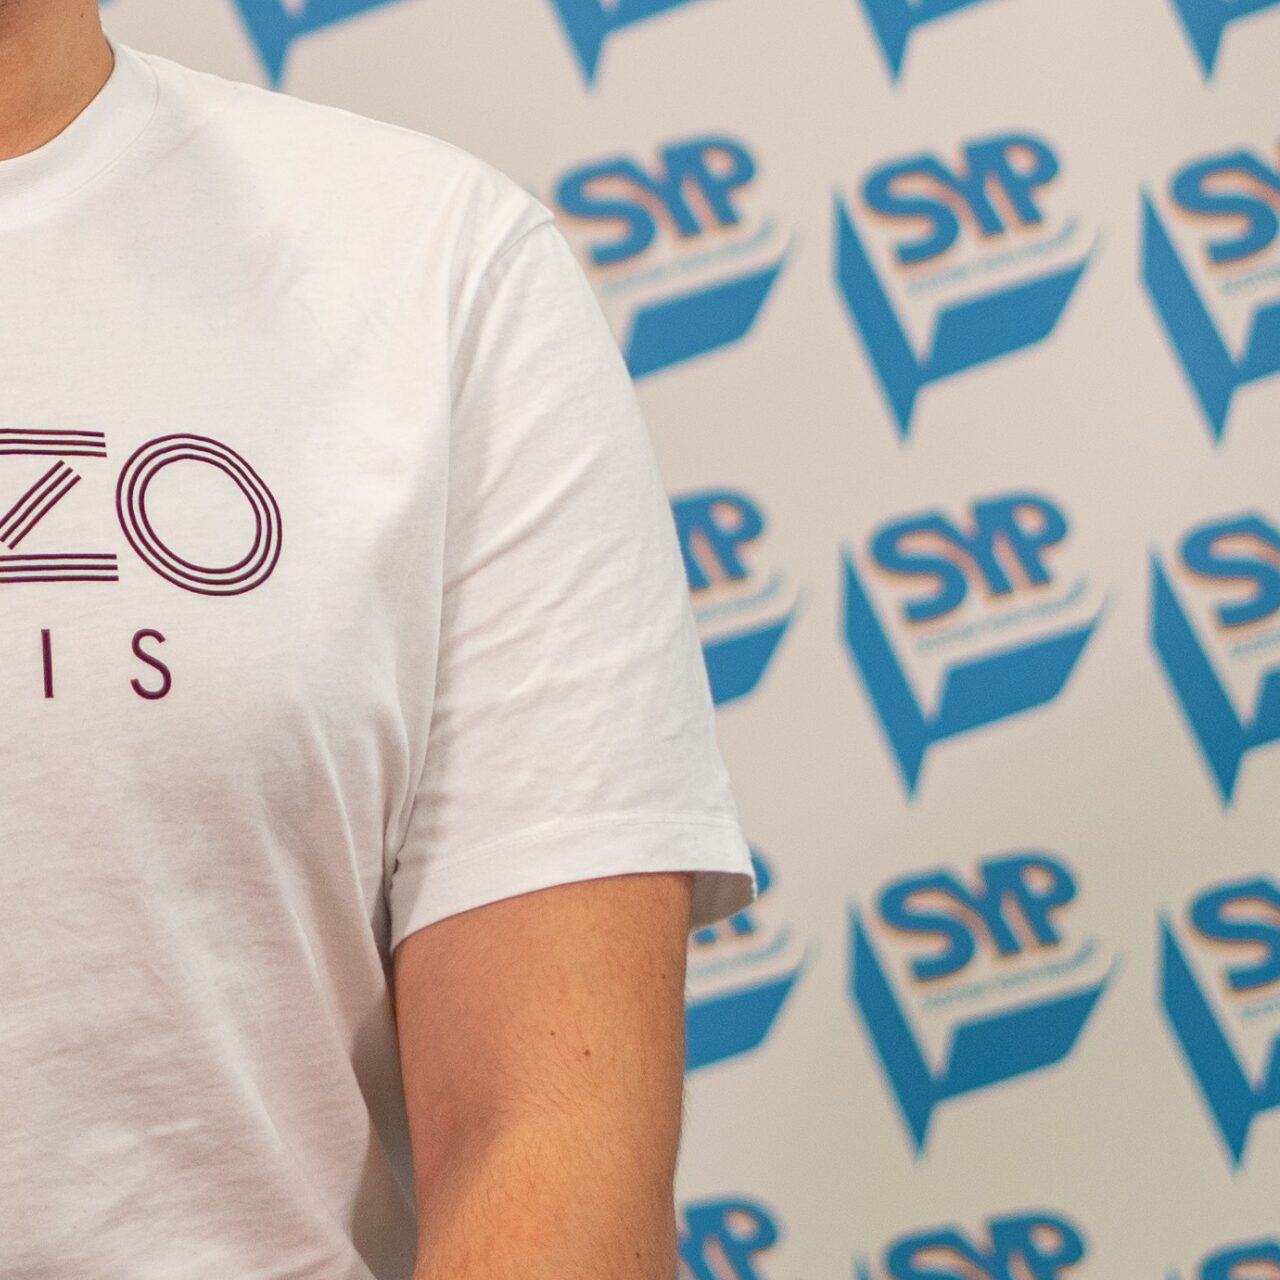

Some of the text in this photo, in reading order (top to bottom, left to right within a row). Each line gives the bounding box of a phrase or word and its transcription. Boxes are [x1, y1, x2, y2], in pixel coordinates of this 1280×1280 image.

[556, 137, 757, 263] SYP
[863, 134, 1061, 262] SYP
[870, 494, 1069, 620] SYP
[878, 854, 1077, 978] SYP
